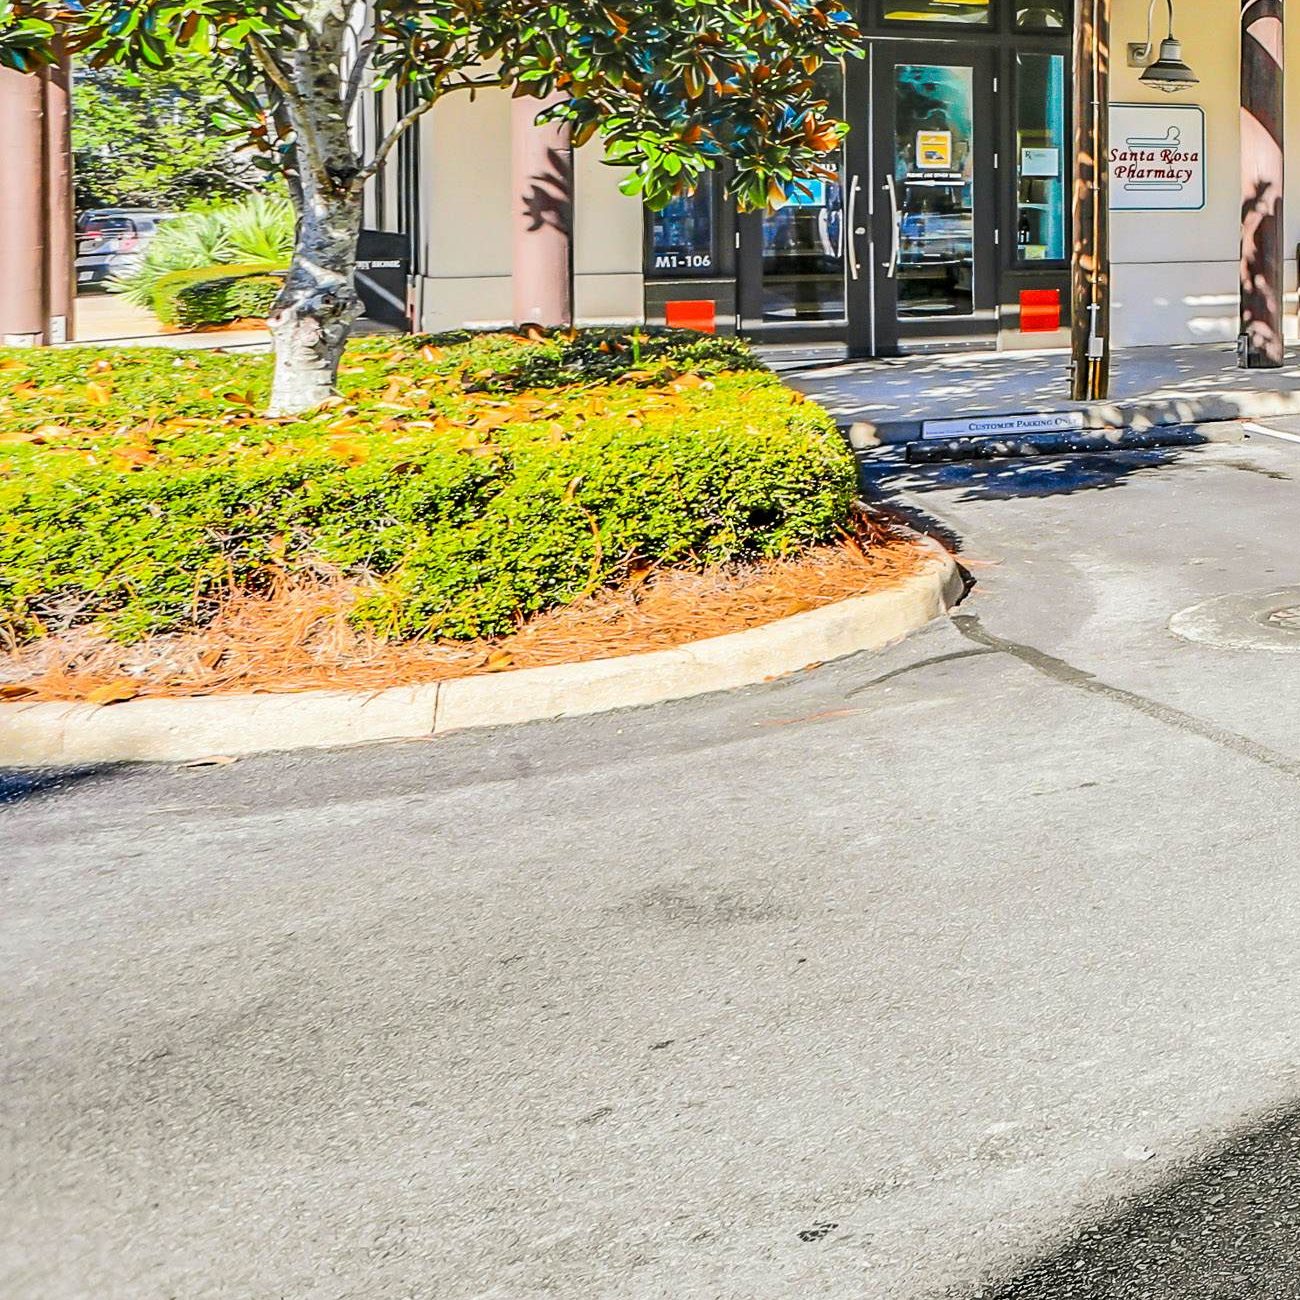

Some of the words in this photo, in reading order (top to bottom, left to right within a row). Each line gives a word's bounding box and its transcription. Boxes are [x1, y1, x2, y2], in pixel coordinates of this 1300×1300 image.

[1108, 148, 1155, 162] Santa
[1160, 149, 1199, 164] Rosa
[1114, 164, 1193, 184] Pharmacy
[655, 255, 711, 268] M1-106
